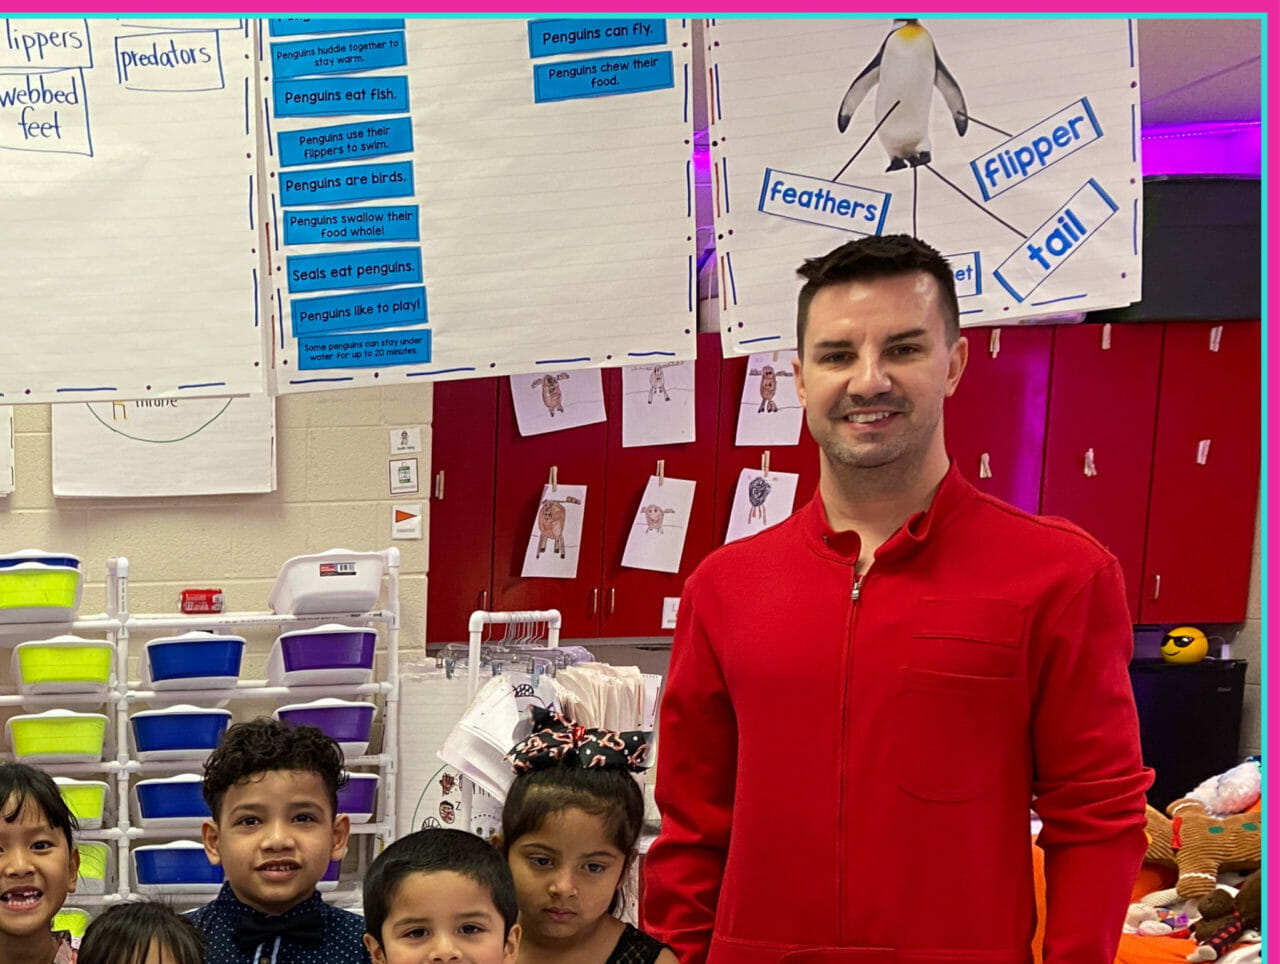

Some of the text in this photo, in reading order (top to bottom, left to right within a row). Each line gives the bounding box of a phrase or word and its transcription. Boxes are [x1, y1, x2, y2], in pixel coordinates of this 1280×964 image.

[543, 22, 653, 44] Penguins can fly.
[276, 40, 399, 60] Penguins huddle together to
[120, 40, 212, 81] predators
[315, 58, 334, 67] stay
[548, 57, 659, 79] Penguins chew their
[591, 76, 620, 88] food.
[285, 88, 397, 105] Penguins eat fish.
[18, 105, 61, 140] feet
[299, 126, 390, 146] Penguins use their
[304, 141, 389, 159] flippers to swim.
[983, 114, 1088, 190] flipper
[286, 171, 406, 192] Penguins are birds.
[769, 180, 878, 223] feathers
[290, 211, 413, 227] Penguins swallow their
[321, 226, 384, 238] food whole!
[1026, 207, 1090, 272] tail
[293, 261, 416, 281] Seals eat penguins.
[300, 299, 420, 322] Penguins like to play!
[304, 343, 327, 352] Some
[328, 341, 363, 351] penguins
[381, 339, 398, 348] stay
[400, 337, 423, 345] under
[310, 353, 333, 361] water
[336, 351, 350, 359] for
[352, 351, 362, 359] up
[374, 349, 384, 357] 20
